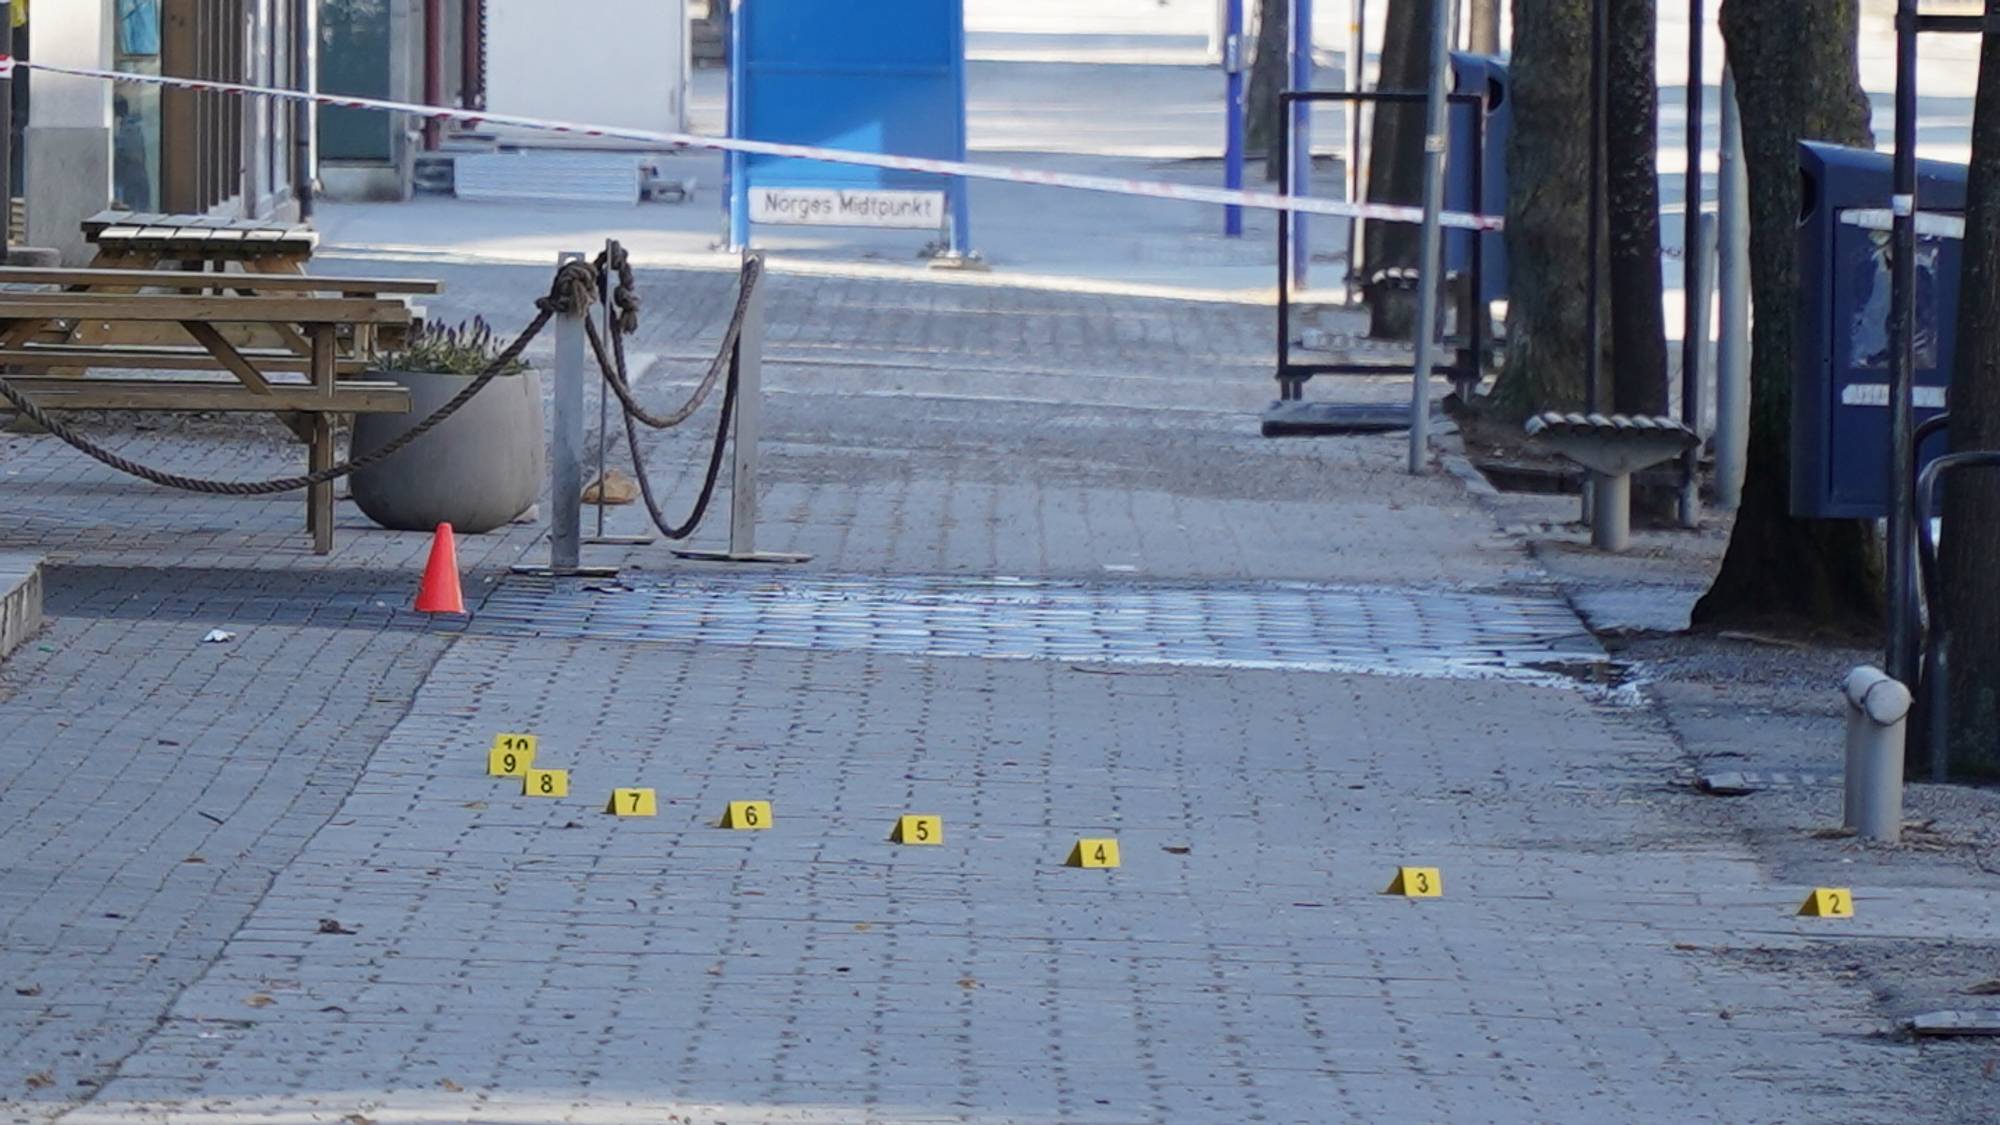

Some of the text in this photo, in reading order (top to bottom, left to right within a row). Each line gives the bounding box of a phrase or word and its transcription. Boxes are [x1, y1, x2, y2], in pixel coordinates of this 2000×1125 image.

[764, 193, 932, 219] Norges Midtpunkt
[503, 753, 516, 773] 9
[540, 774, 553, 793] 8
[628, 793, 641, 812] 7
[745, 805, 758, 826] 6
[916, 820, 929, 841] 5
[1094, 843, 1107, 864] 4
[1416, 872, 1429, 894] 3
[1828, 893, 1842, 914] 2
